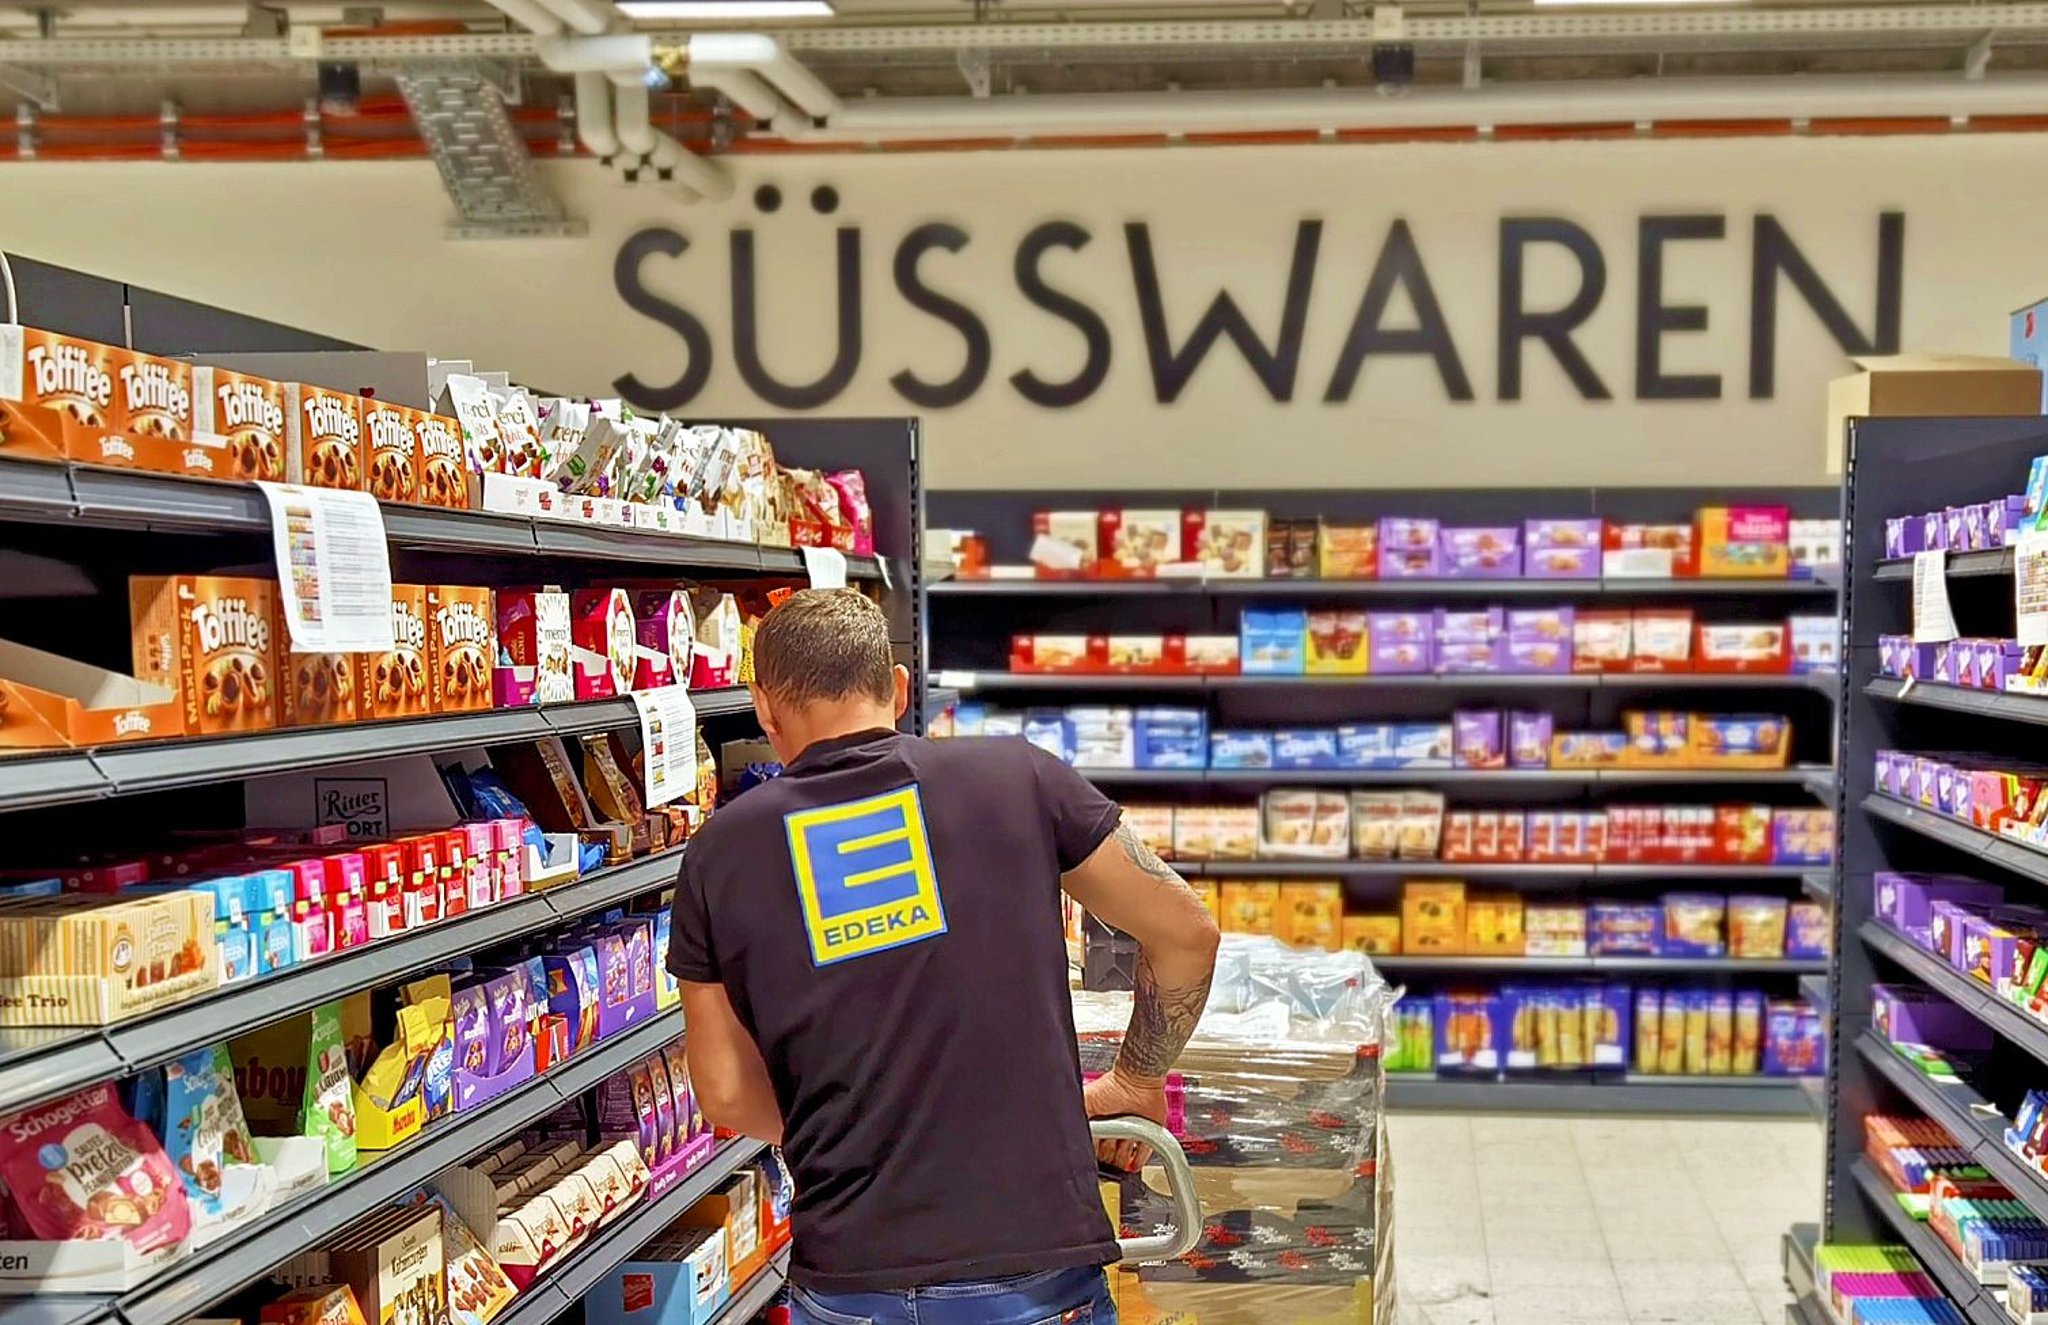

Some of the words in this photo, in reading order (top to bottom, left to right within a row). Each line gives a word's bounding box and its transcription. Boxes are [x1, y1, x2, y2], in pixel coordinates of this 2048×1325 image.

[611, 184, 1906, 409] SÜSSWAREN
[27, 344, 111, 406] Toffifee
[120, 363, 190, 420] Toffifee
[218, 382, 284, 436] Toffifee
[304, 395, 358, 446] Toffifee
[367, 410, 415, 457] Toffifee
[416, 420, 463, 464] Toffifee
[191, 597, 270, 654] Toffifee
[392, 600, 426, 650] fifee
[436, 602, 488, 648] Toffifee
[180, 605, 198, 724] Maxi-Pack
[322, 790, 382, 820] Ritter
[823, 904, 930, 947] EDEKA
[27, 994, 68, 1009] Trio
[10, 1088, 109, 1144] Schogetten
